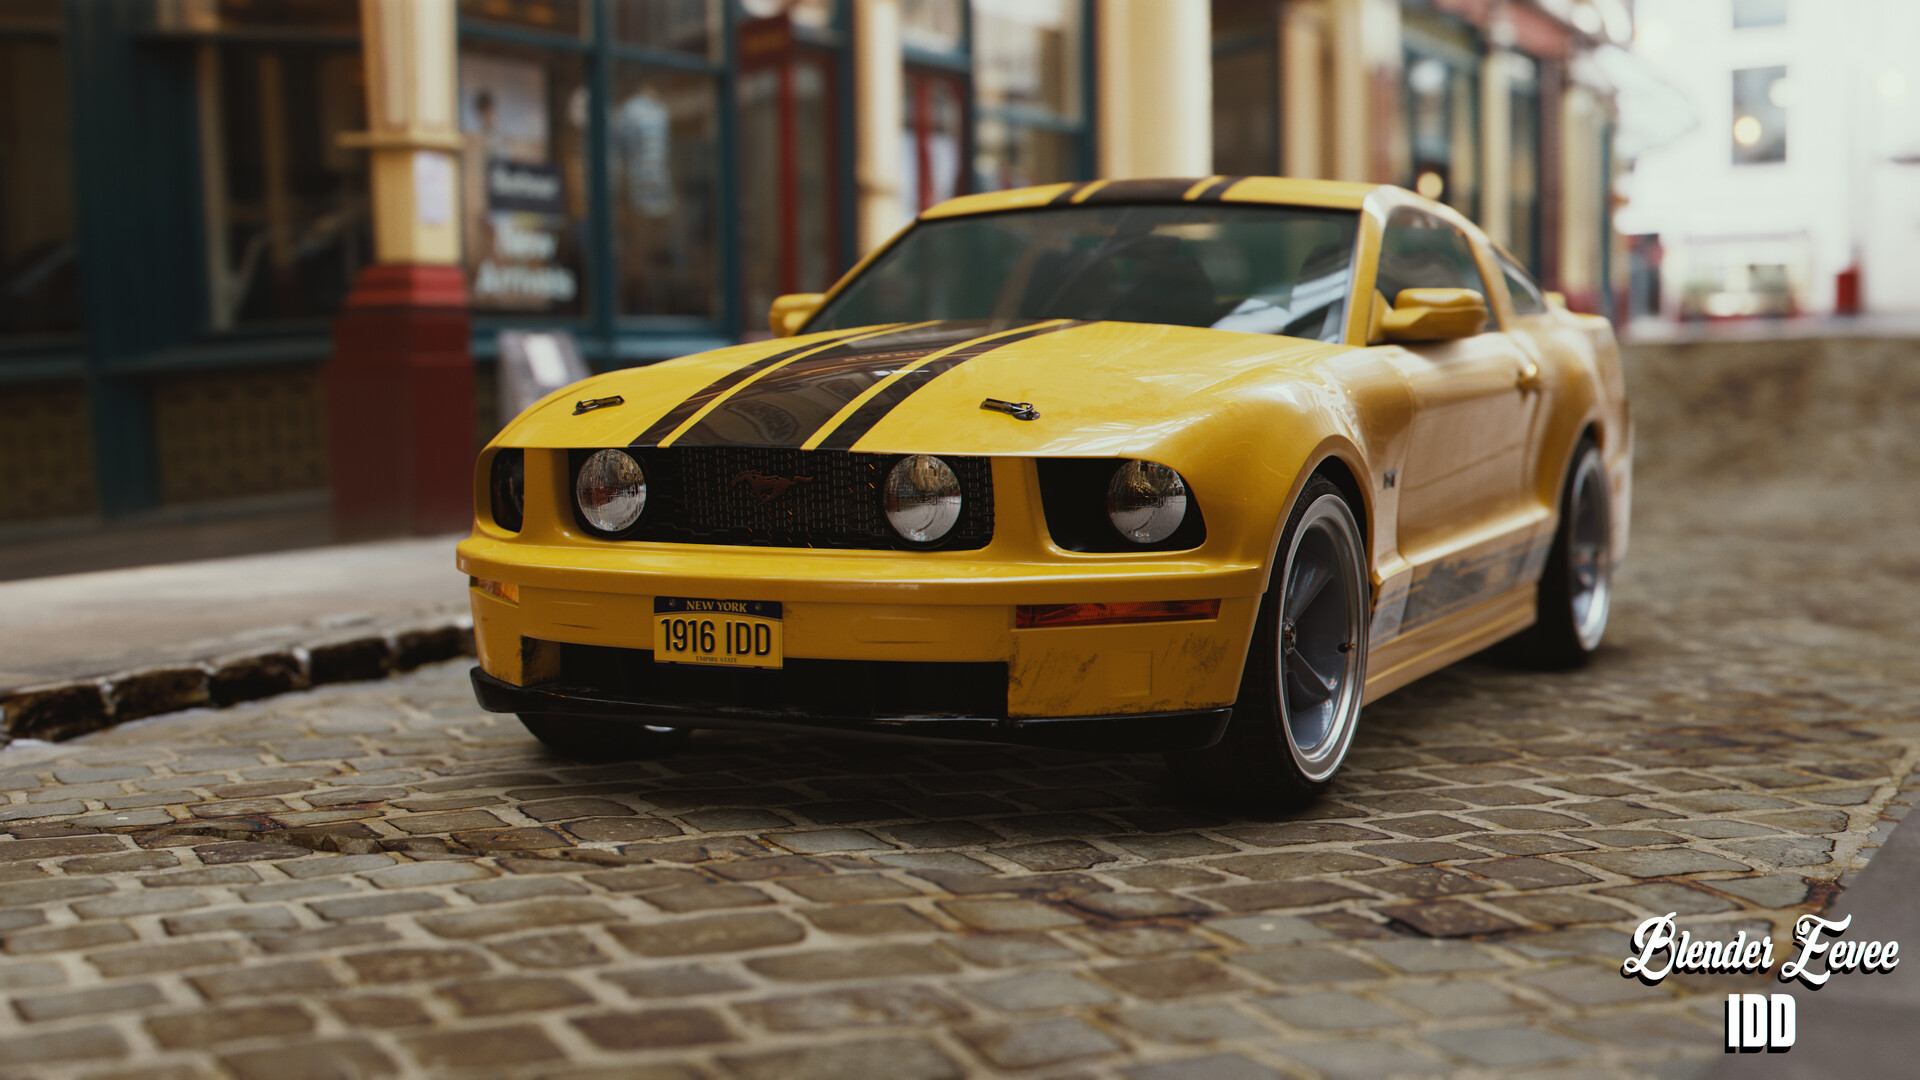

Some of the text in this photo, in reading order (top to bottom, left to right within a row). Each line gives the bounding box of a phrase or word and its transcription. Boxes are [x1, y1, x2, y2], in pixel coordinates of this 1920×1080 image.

[686, 600, 748, 613] NEW YORK
[661, 618, 771, 656] 1916 IDD
